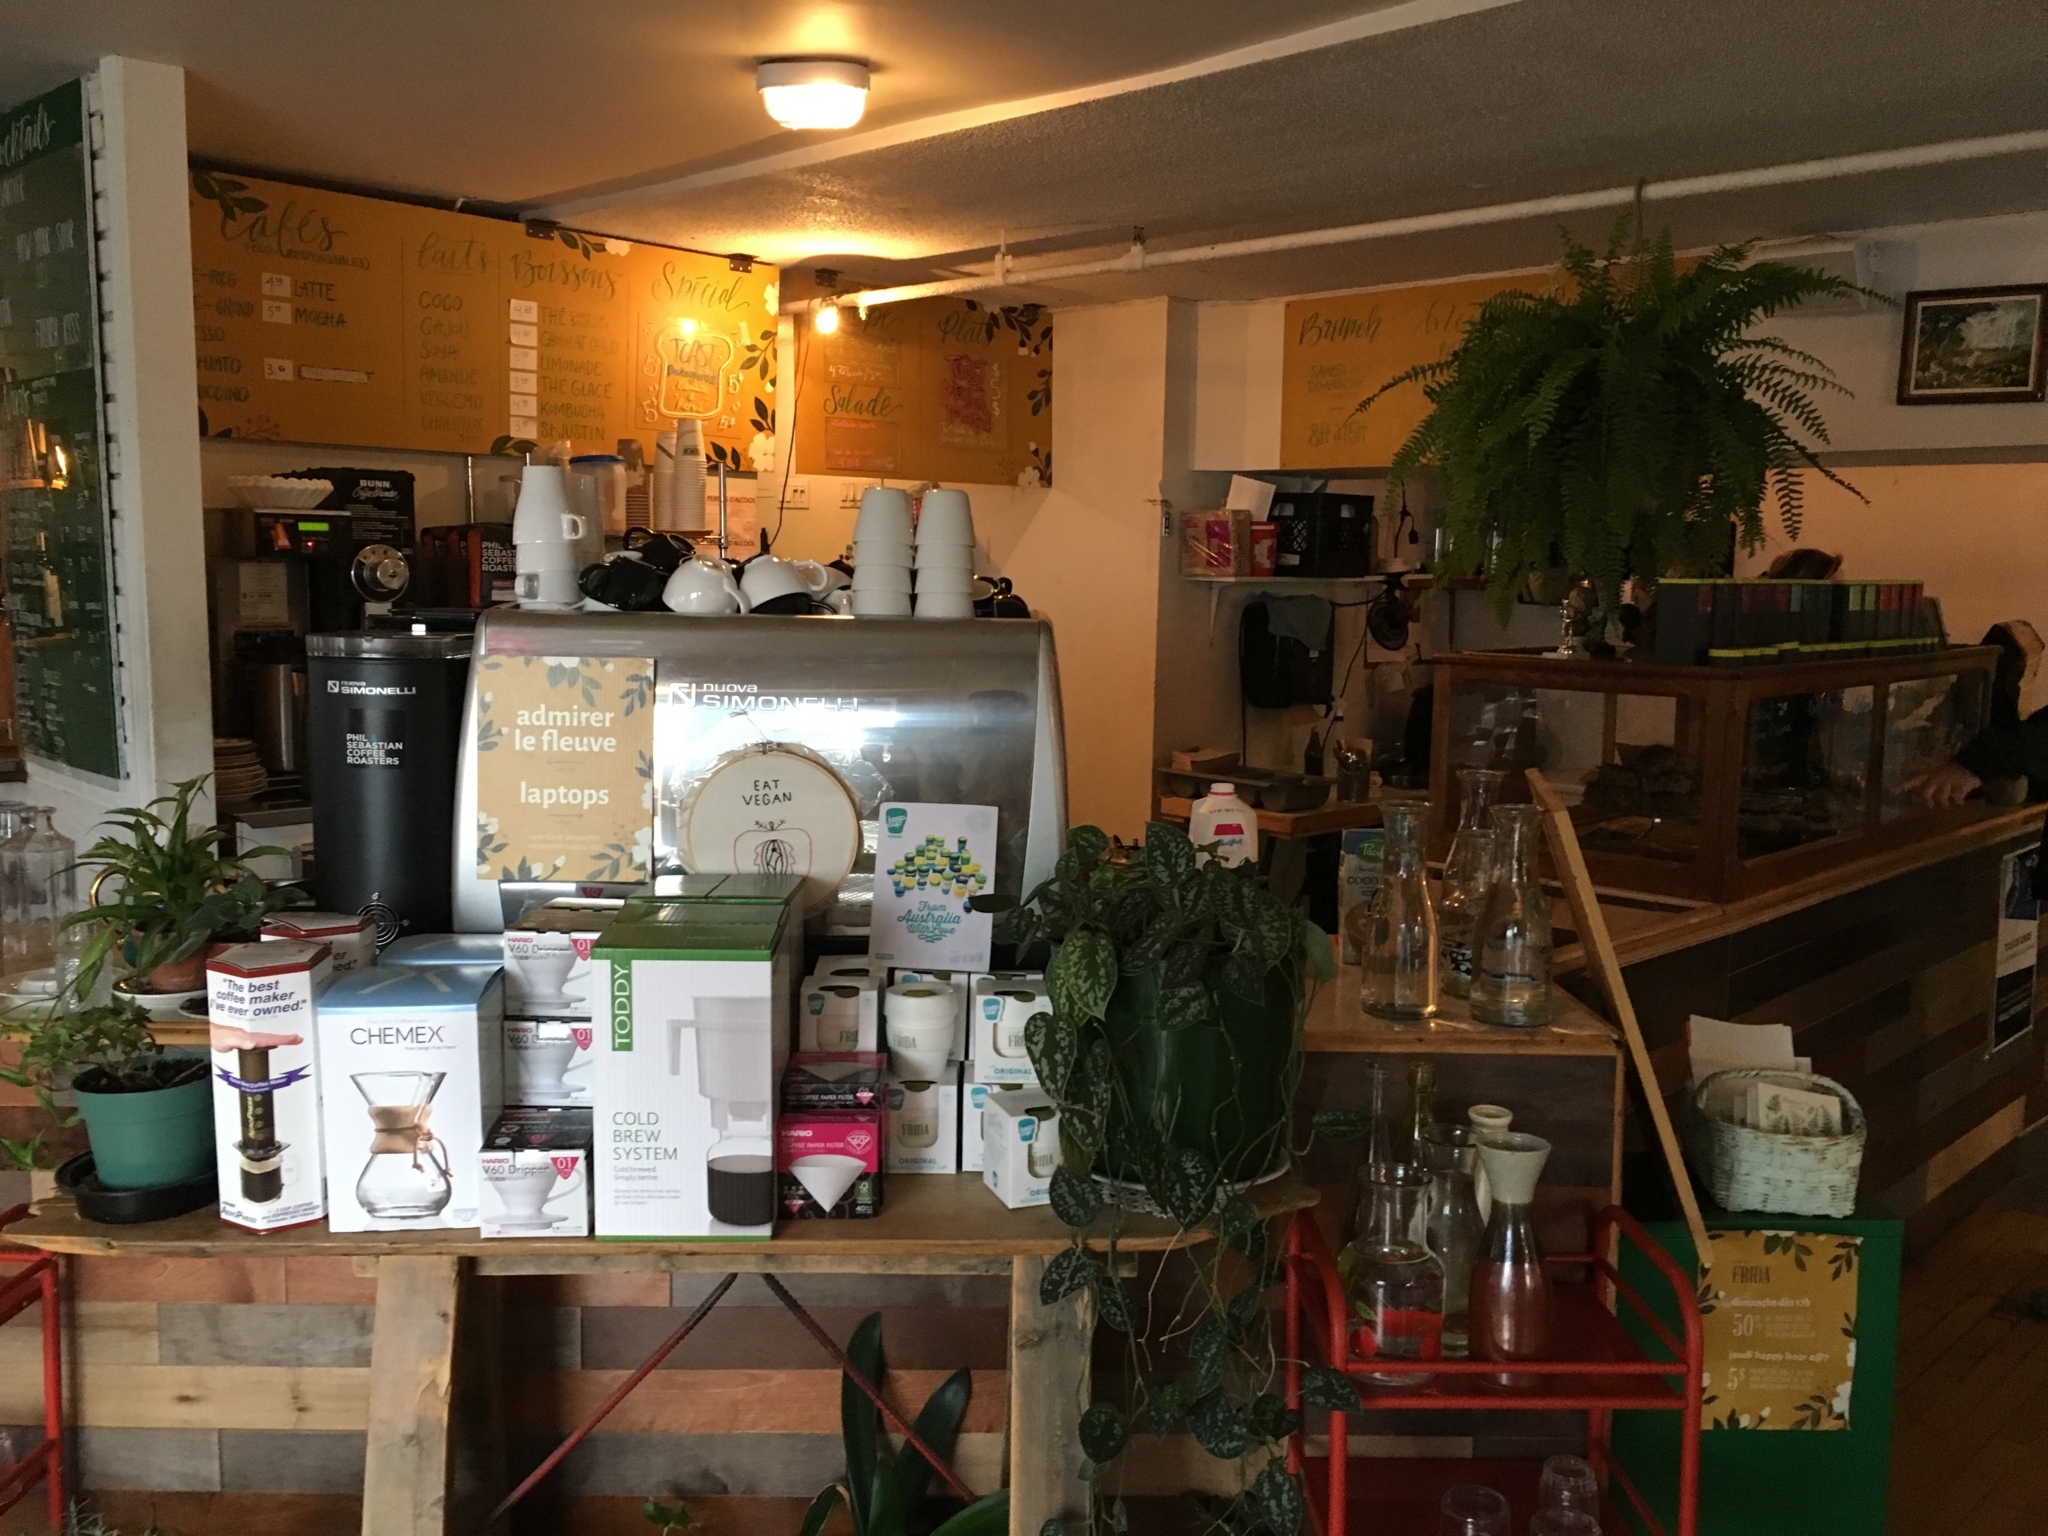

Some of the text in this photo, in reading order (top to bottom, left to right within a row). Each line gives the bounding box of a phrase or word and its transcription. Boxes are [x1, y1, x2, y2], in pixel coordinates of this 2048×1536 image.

[510, 249, 624, 300] Boissons
[293, 279, 337, 301] LATTE
[651, 260, 751, 313] Spécial
[418, 290, 463, 312] COCO
[293, 307, 348, 329] MOCHA
[1298, 303, 1382, 346] Brunch
[540, 356, 604, 377] LIMONADE
[418, 364, 479, 385] AMANDE
[823, 384, 904, 418] Salade
[359, 479, 390, 488] BUNN
[481, 541, 504, 549] PHIL
[481, 549, 516, 557] SEBAST
[341, 686, 416, 695] SIMONELLI
[703, 683, 758, 694] nuova
[702, 694, 859, 712] SIMONELLI
[516, 704, 615, 727] admirer
[346, 733, 369, 742] PHIL
[514, 729, 617, 752] le fleuve
[346, 741, 403, 750] SEBASTIAN
[346, 749, 386, 757] COFFEE
[346, 757, 400, 765] ROASTERS
[753, 779, 781, 791] EAT
[520, 781, 610, 810] laptops
[742, 792, 792, 806] VEGAN
[1359, 842, 1385, 860] Pacif
[917, 900, 947, 912] From
[896, 909, 962, 924] Australia
[508, 944, 529, 953] V60
[576, 939, 591, 951] 01
[248, 980, 280, 993] best
[216, 990, 295, 1005] coffee maker
[209, 998, 307, 1017] I've ever owned."
[350, 1026, 443, 1045] CHEMEX
[507, 1034, 529, 1044] V60
[576, 1029, 591, 1041] 01
[993, 1067, 1032, 1075] ORIGINAL
[612, 1111, 660, 1126] COLD
[612, 1129, 662, 1143] BREW
[781, 1129, 813, 1137] HARIO
[901, 1123, 930, 1136] FRIDA
[612, 1146, 678, 1161] SYSTEM
[556, 1157, 572, 1169] 01
[482, 1164, 550, 1177] V60 Dripper
[1731, 1265, 1771, 1284] FRIDA
